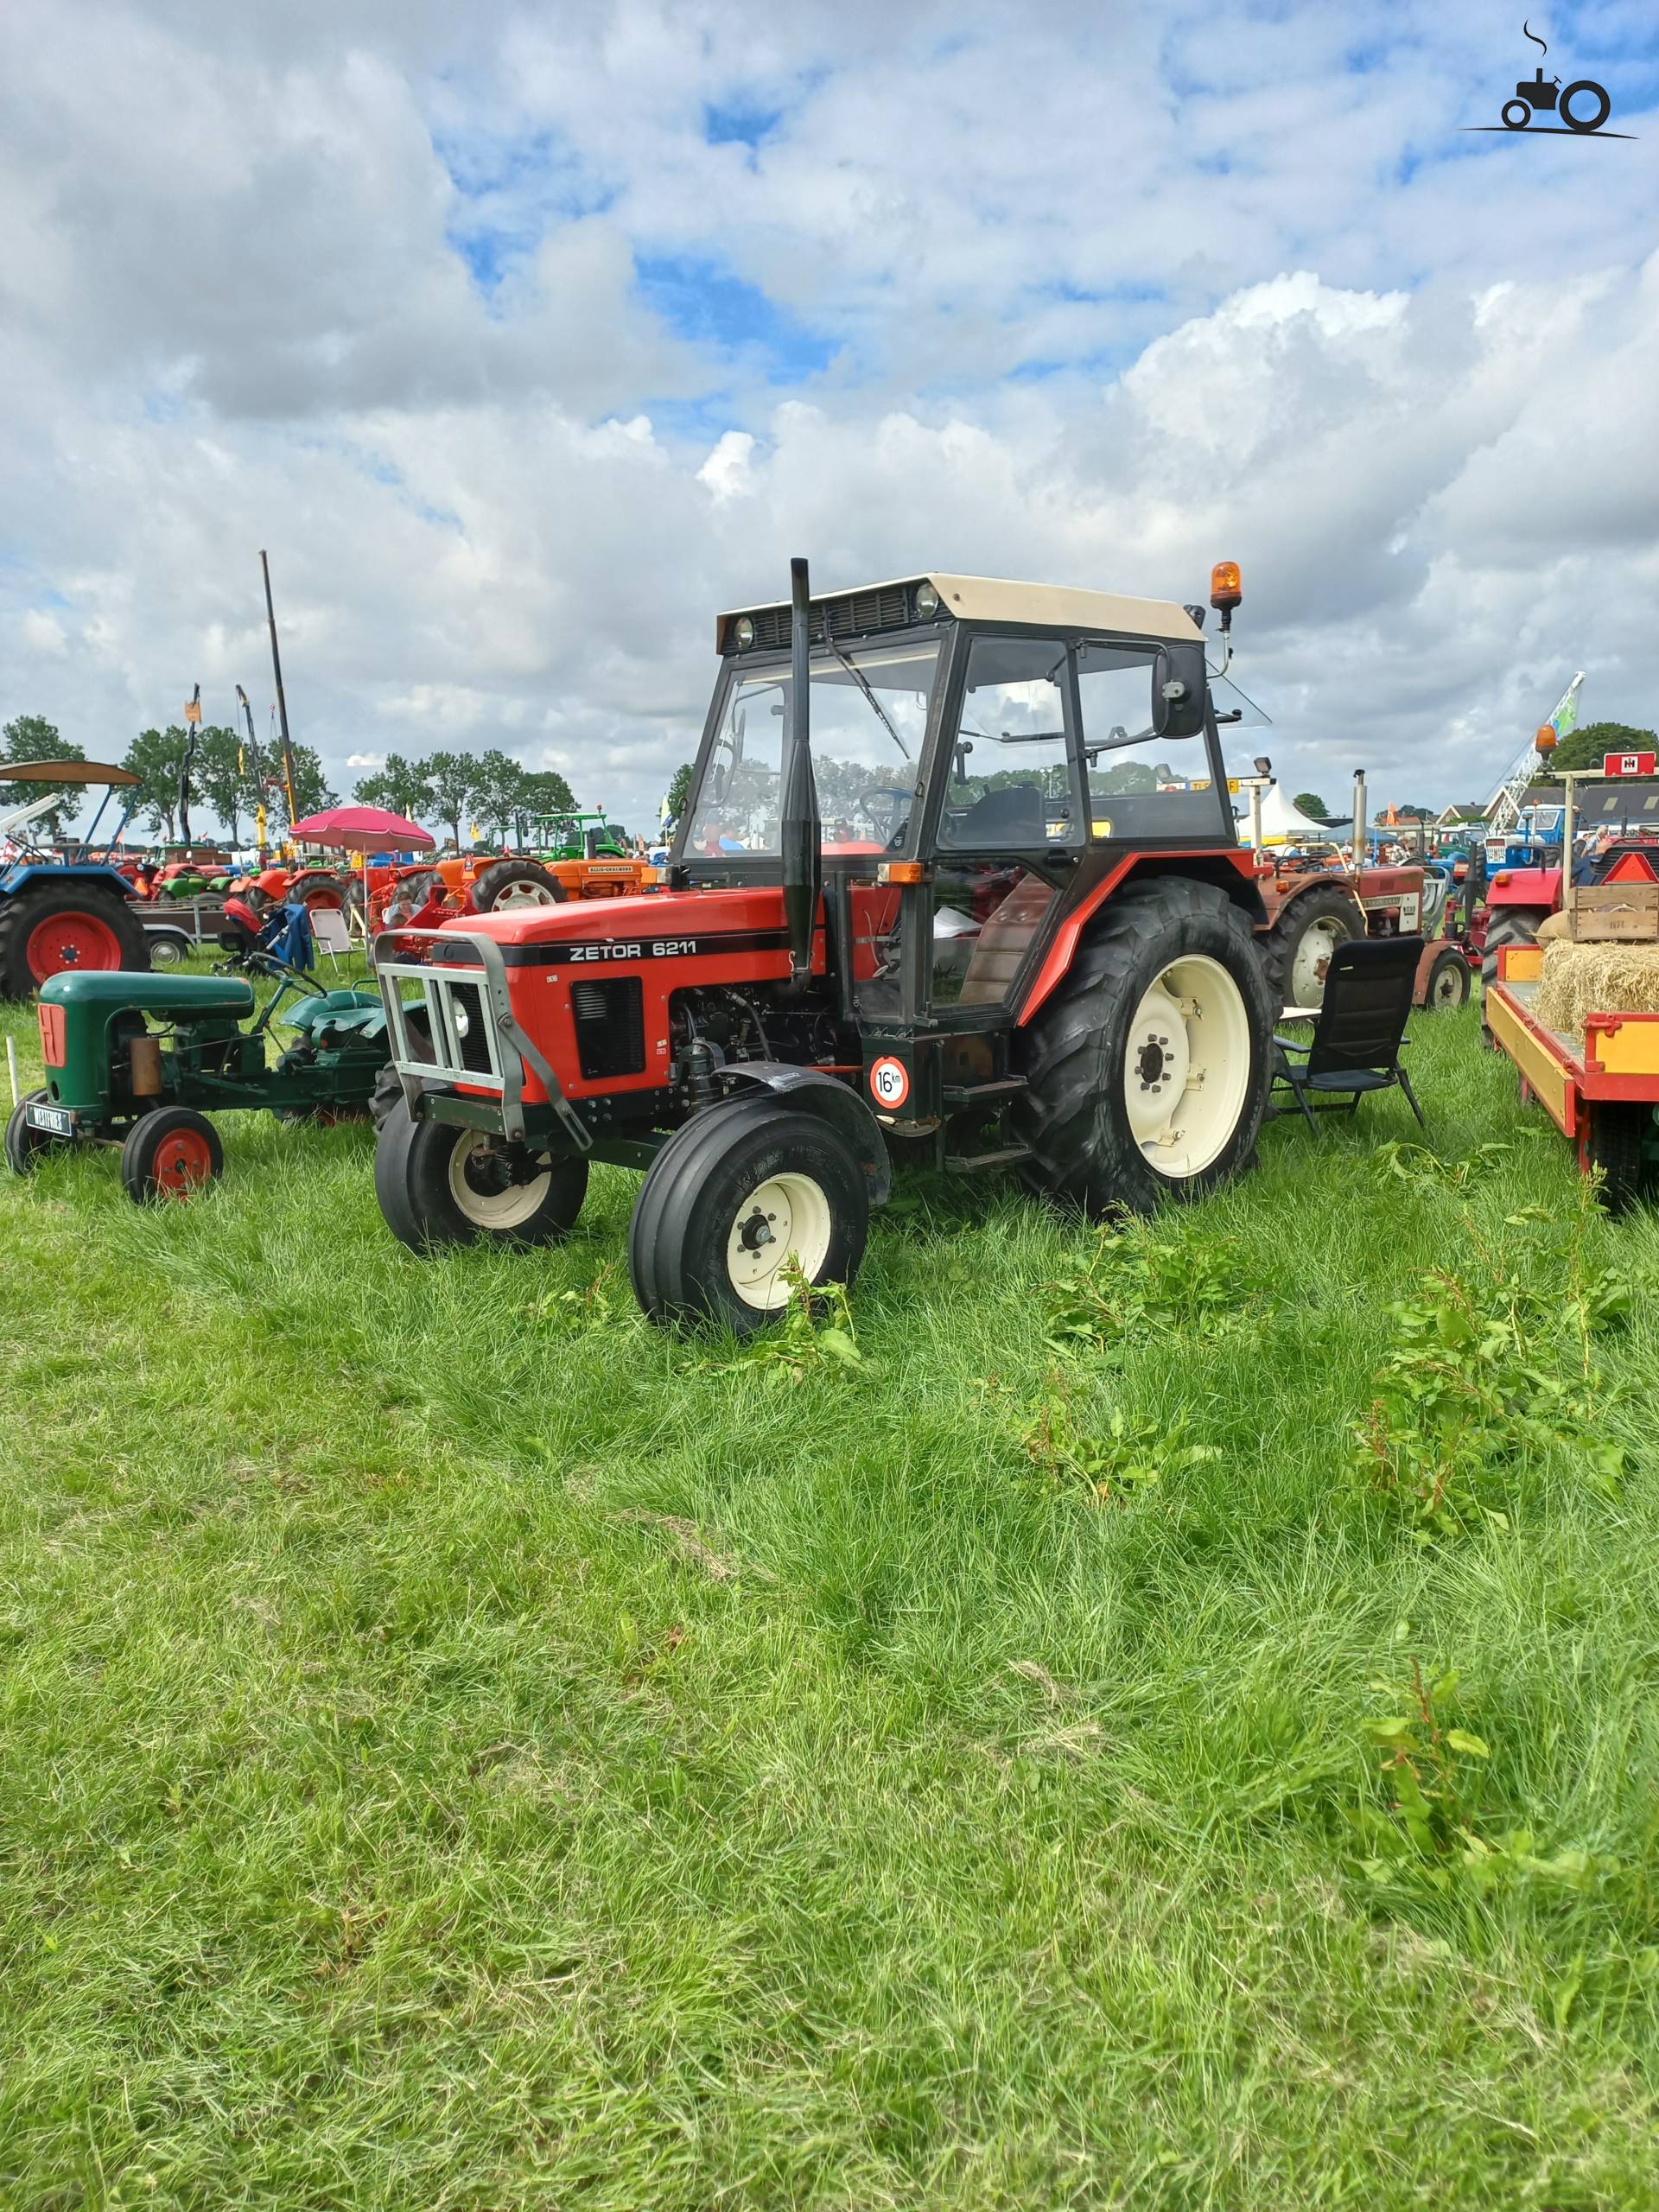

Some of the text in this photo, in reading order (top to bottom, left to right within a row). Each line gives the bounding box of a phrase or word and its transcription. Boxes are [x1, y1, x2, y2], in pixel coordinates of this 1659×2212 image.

[569, 941, 696, 961] ZETOR 6211
[878, 1071, 901, 1093] 16 km
[33, 1106, 63, 1131] WESTFRIES
